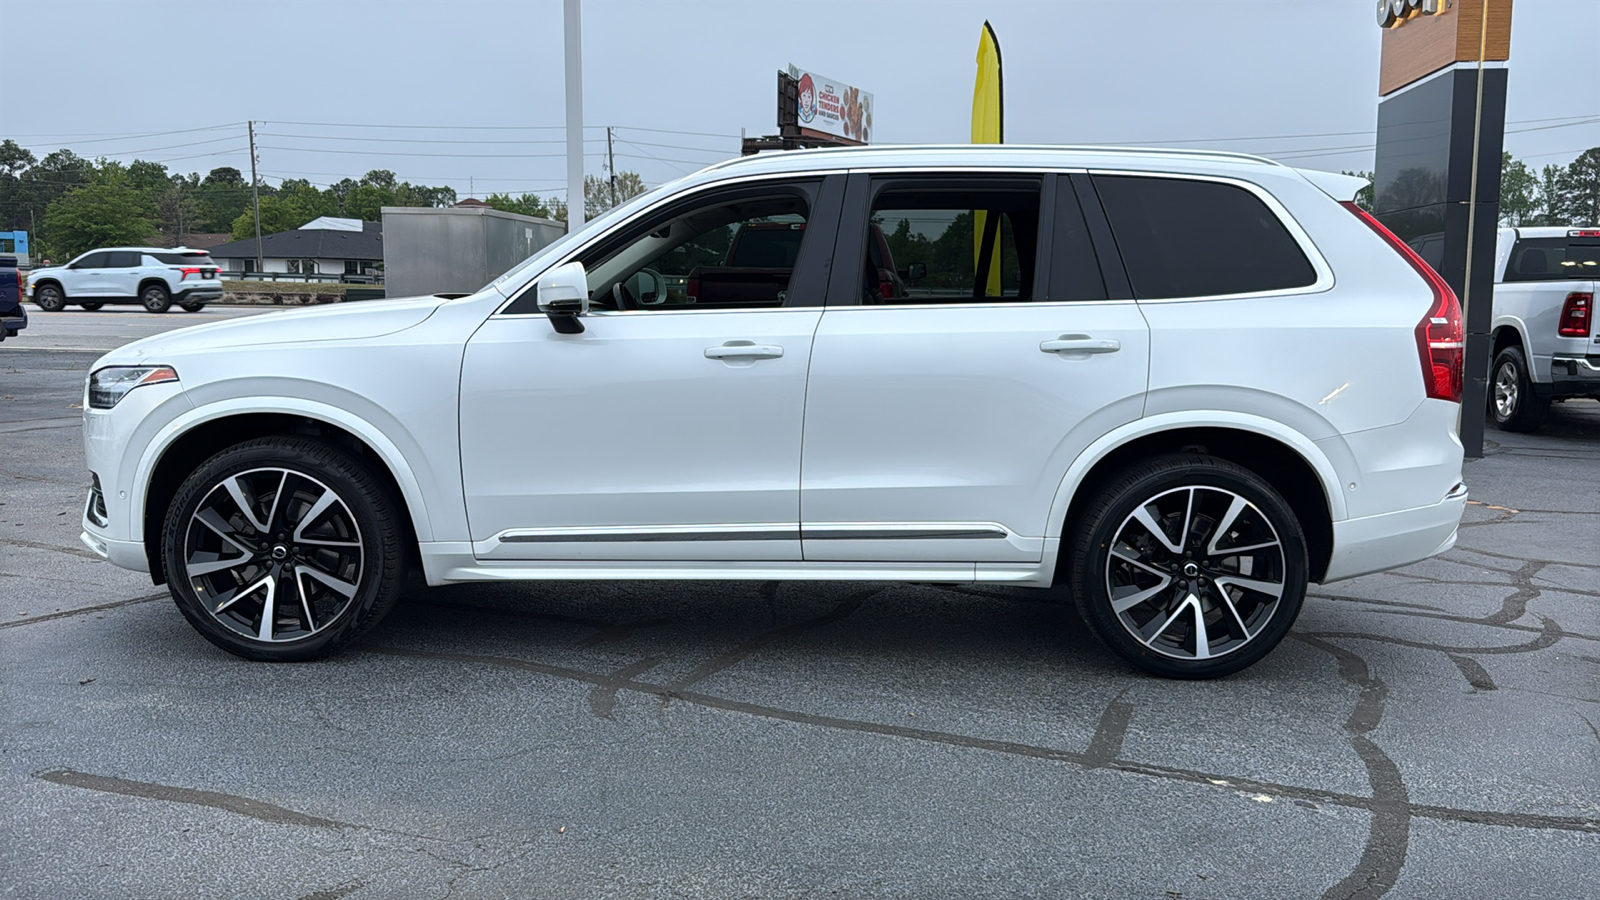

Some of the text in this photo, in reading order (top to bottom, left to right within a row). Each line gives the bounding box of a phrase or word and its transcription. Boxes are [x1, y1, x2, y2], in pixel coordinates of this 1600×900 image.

[819, 91, 839, 104] CHICKEN
[819, 100, 839, 114] TENDERS
[826, 112, 839, 121] SAUCES
